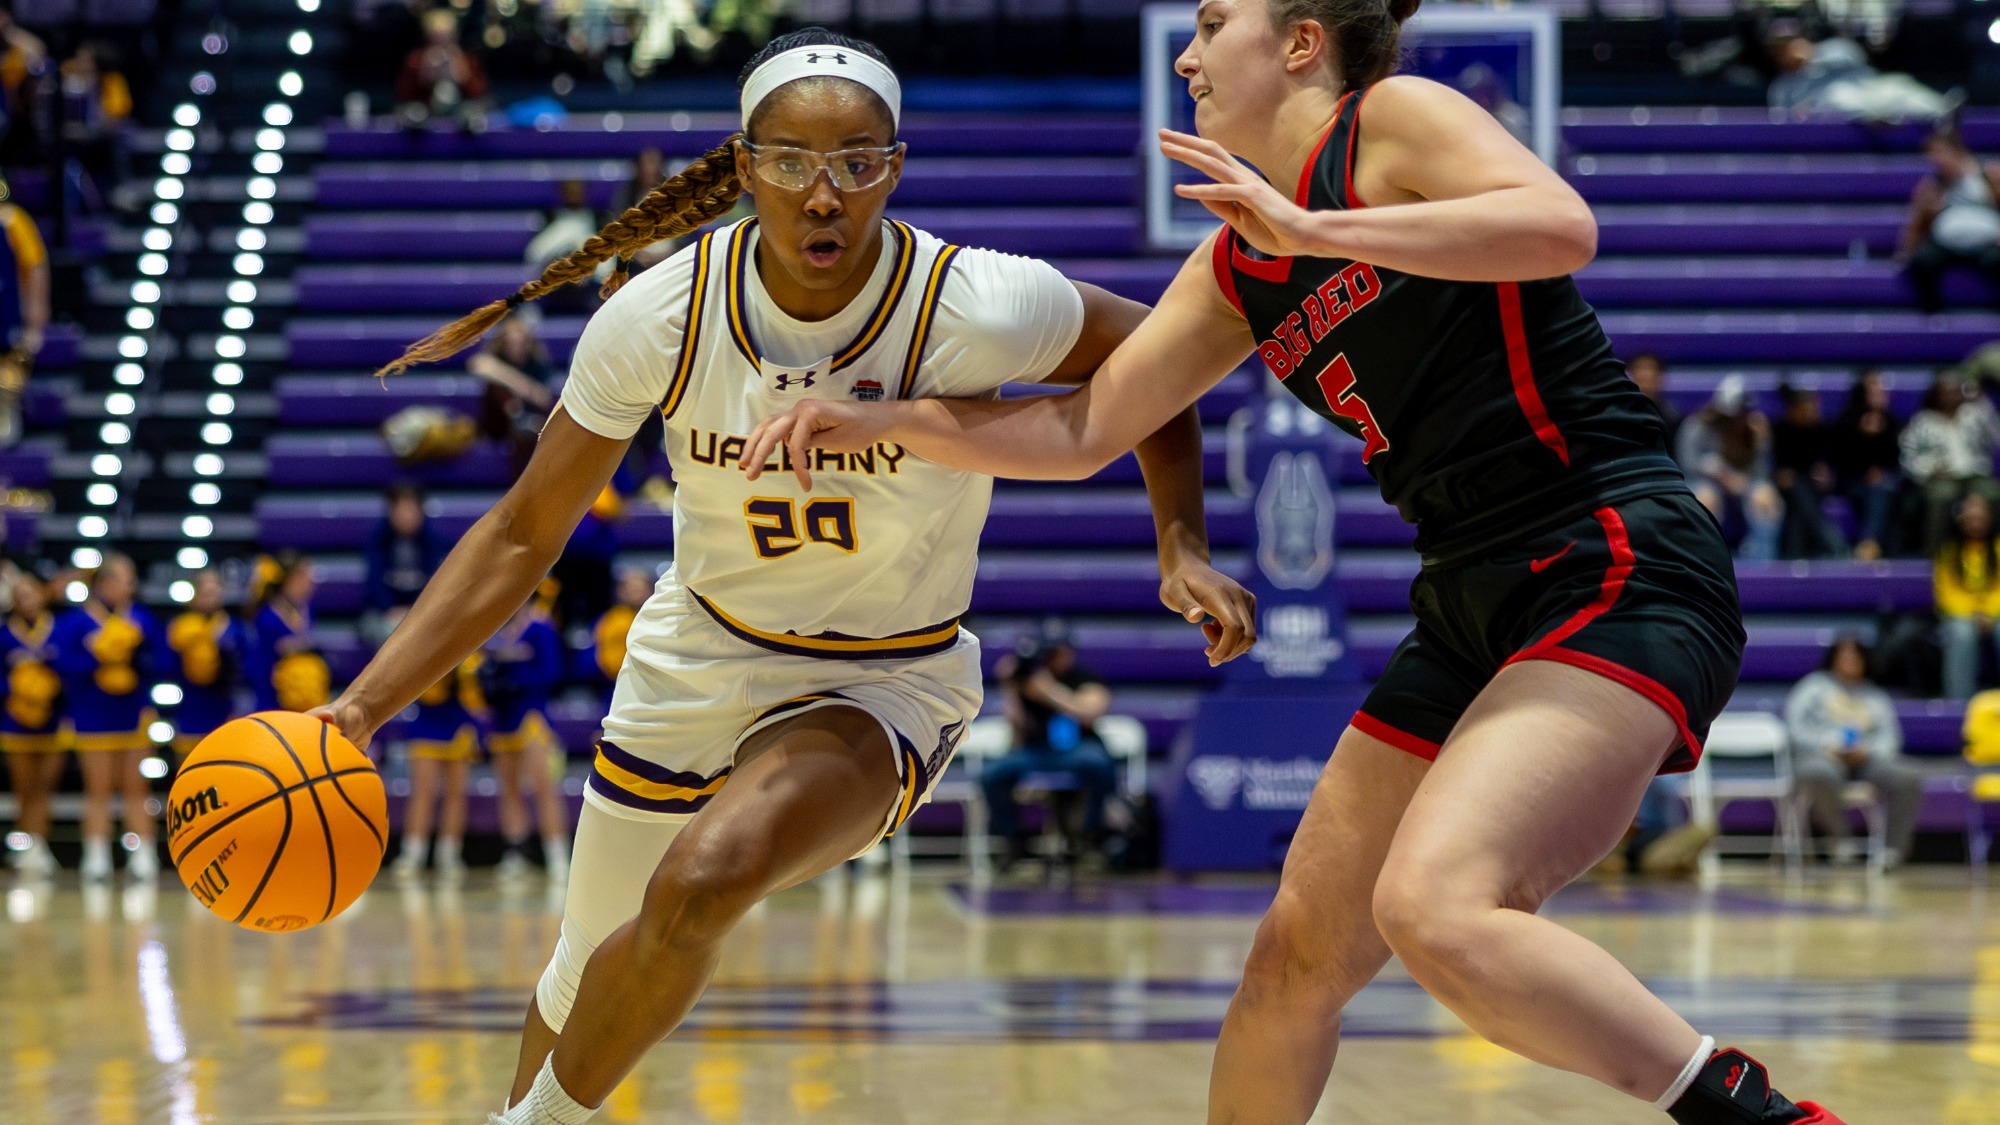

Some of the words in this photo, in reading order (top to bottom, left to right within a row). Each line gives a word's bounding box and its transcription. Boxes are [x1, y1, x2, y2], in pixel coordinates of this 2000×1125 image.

[1257, 311, 1312, 382] BIG
[1301, 261, 1382, 343] RED
[1315, 352, 1390, 465] 5
[743, 495, 858, 560] 20
[217, 838, 238, 865] NXT
